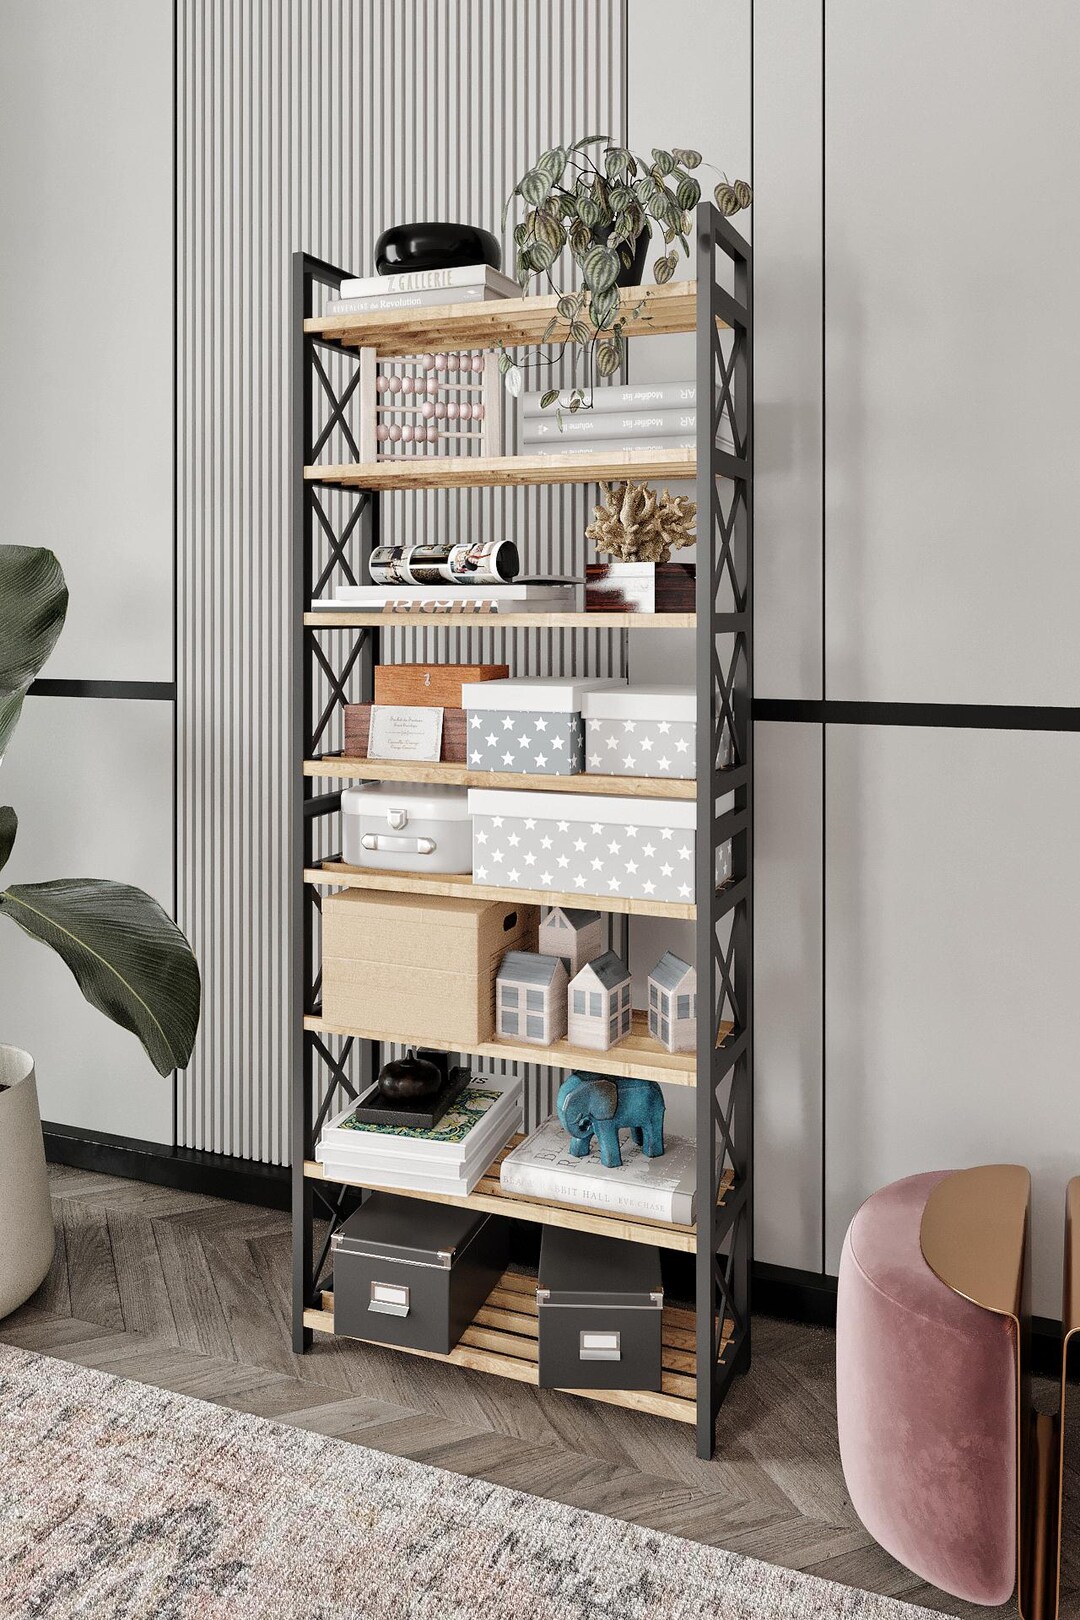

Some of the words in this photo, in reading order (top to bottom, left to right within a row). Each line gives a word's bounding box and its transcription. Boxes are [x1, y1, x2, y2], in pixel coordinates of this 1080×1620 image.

[388, 276, 395, 292] Z
[399, 270, 453, 291] GALLERIE
[380, 297, 422, 309] Revolution
[622, 392, 633, 401] list
[634, 390, 664, 400] Modifier
[568, 421, 594, 431] volume
[622, 419, 633, 429] list
[634, 417, 664, 428] Modifier
[582, 1189, 611, 1203] HALL
[618, 1197, 634, 1208] EVE
[636, 1200, 665, 1213] CHASE
